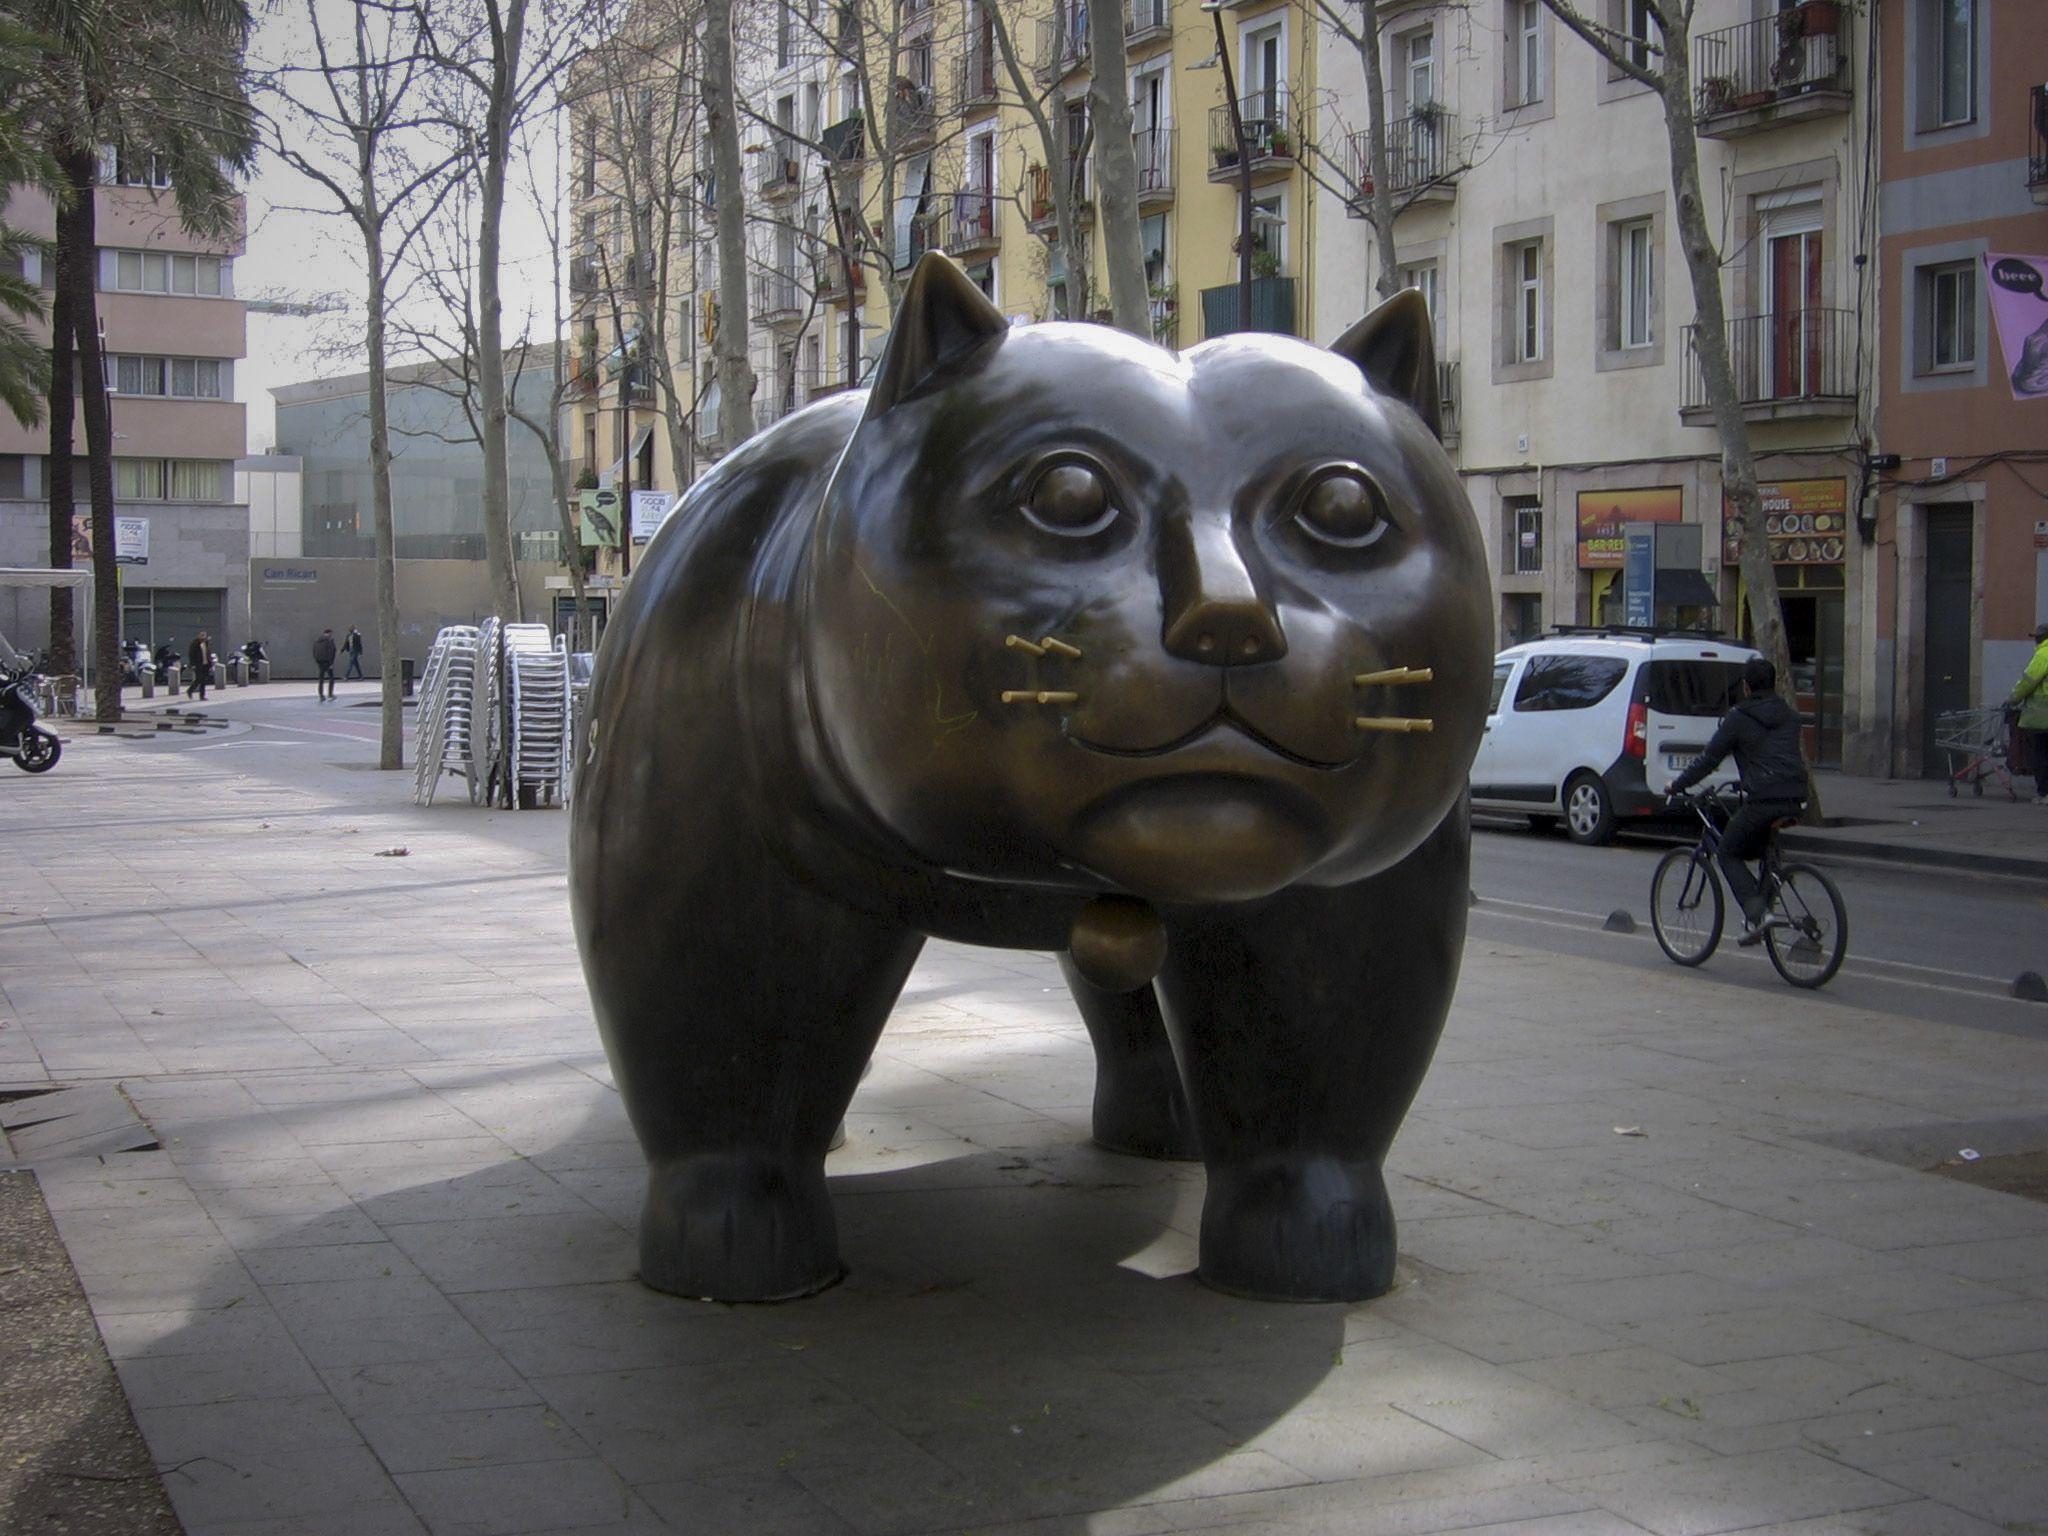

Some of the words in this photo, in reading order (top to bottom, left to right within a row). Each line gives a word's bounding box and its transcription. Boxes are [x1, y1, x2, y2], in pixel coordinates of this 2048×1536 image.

[1762, 498, 1791, 511] HOUSE
[263, 568, 284, 578] Can
[287, 568, 317, 578] Ricart
